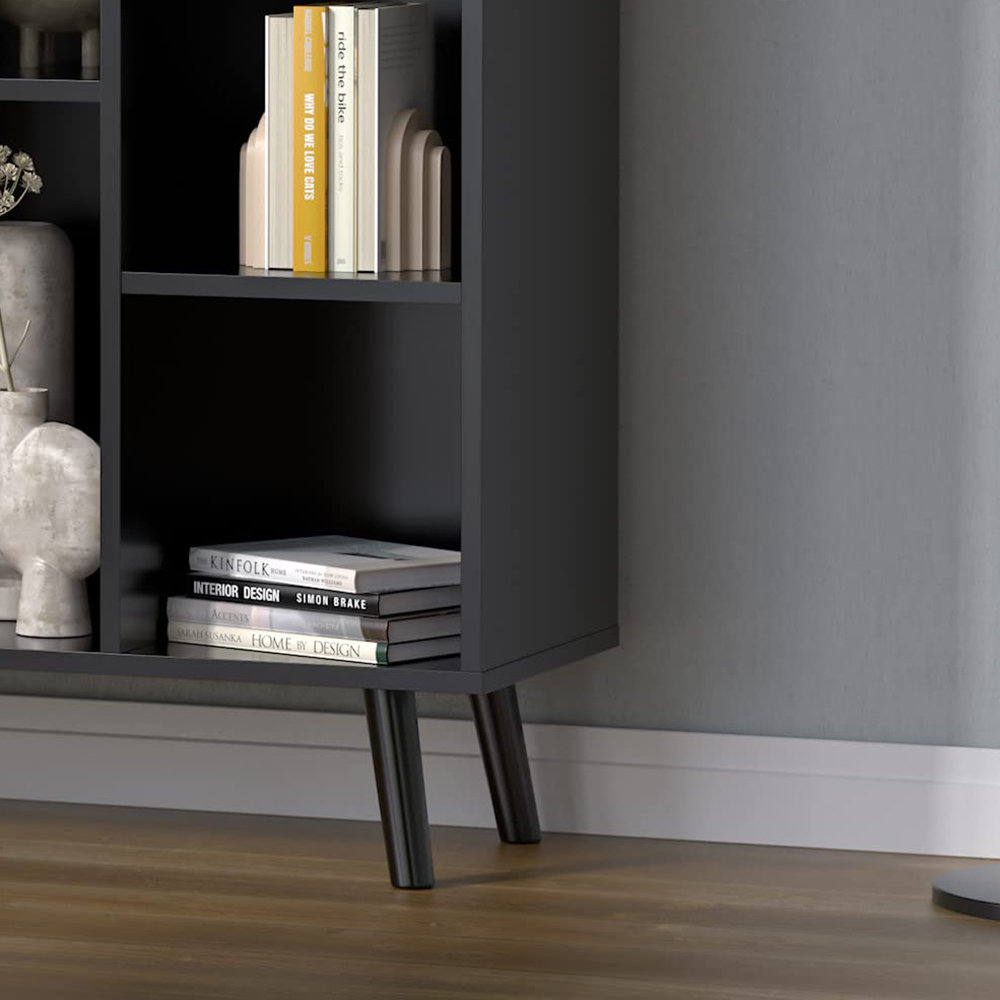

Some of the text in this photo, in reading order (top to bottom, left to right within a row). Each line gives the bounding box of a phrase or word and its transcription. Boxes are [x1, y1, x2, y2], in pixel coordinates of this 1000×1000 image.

[338, 31, 347, 123] ride the bike
[304, 93, 315, 201] WHY DO WE LOVE CATS
[210, 556, 270, 576] KINFOLK
[270, 568, 287, 576] HOME
[193, 581, 366, 610] INTERIOR DESIGN SIMON BRAKE
[204, 631, 243, 644] SUSANKA
[251, 633, 292, 651] HOME
[297, 641, 307, 651] BY
[314, 640, 361, 658] DESIGN
